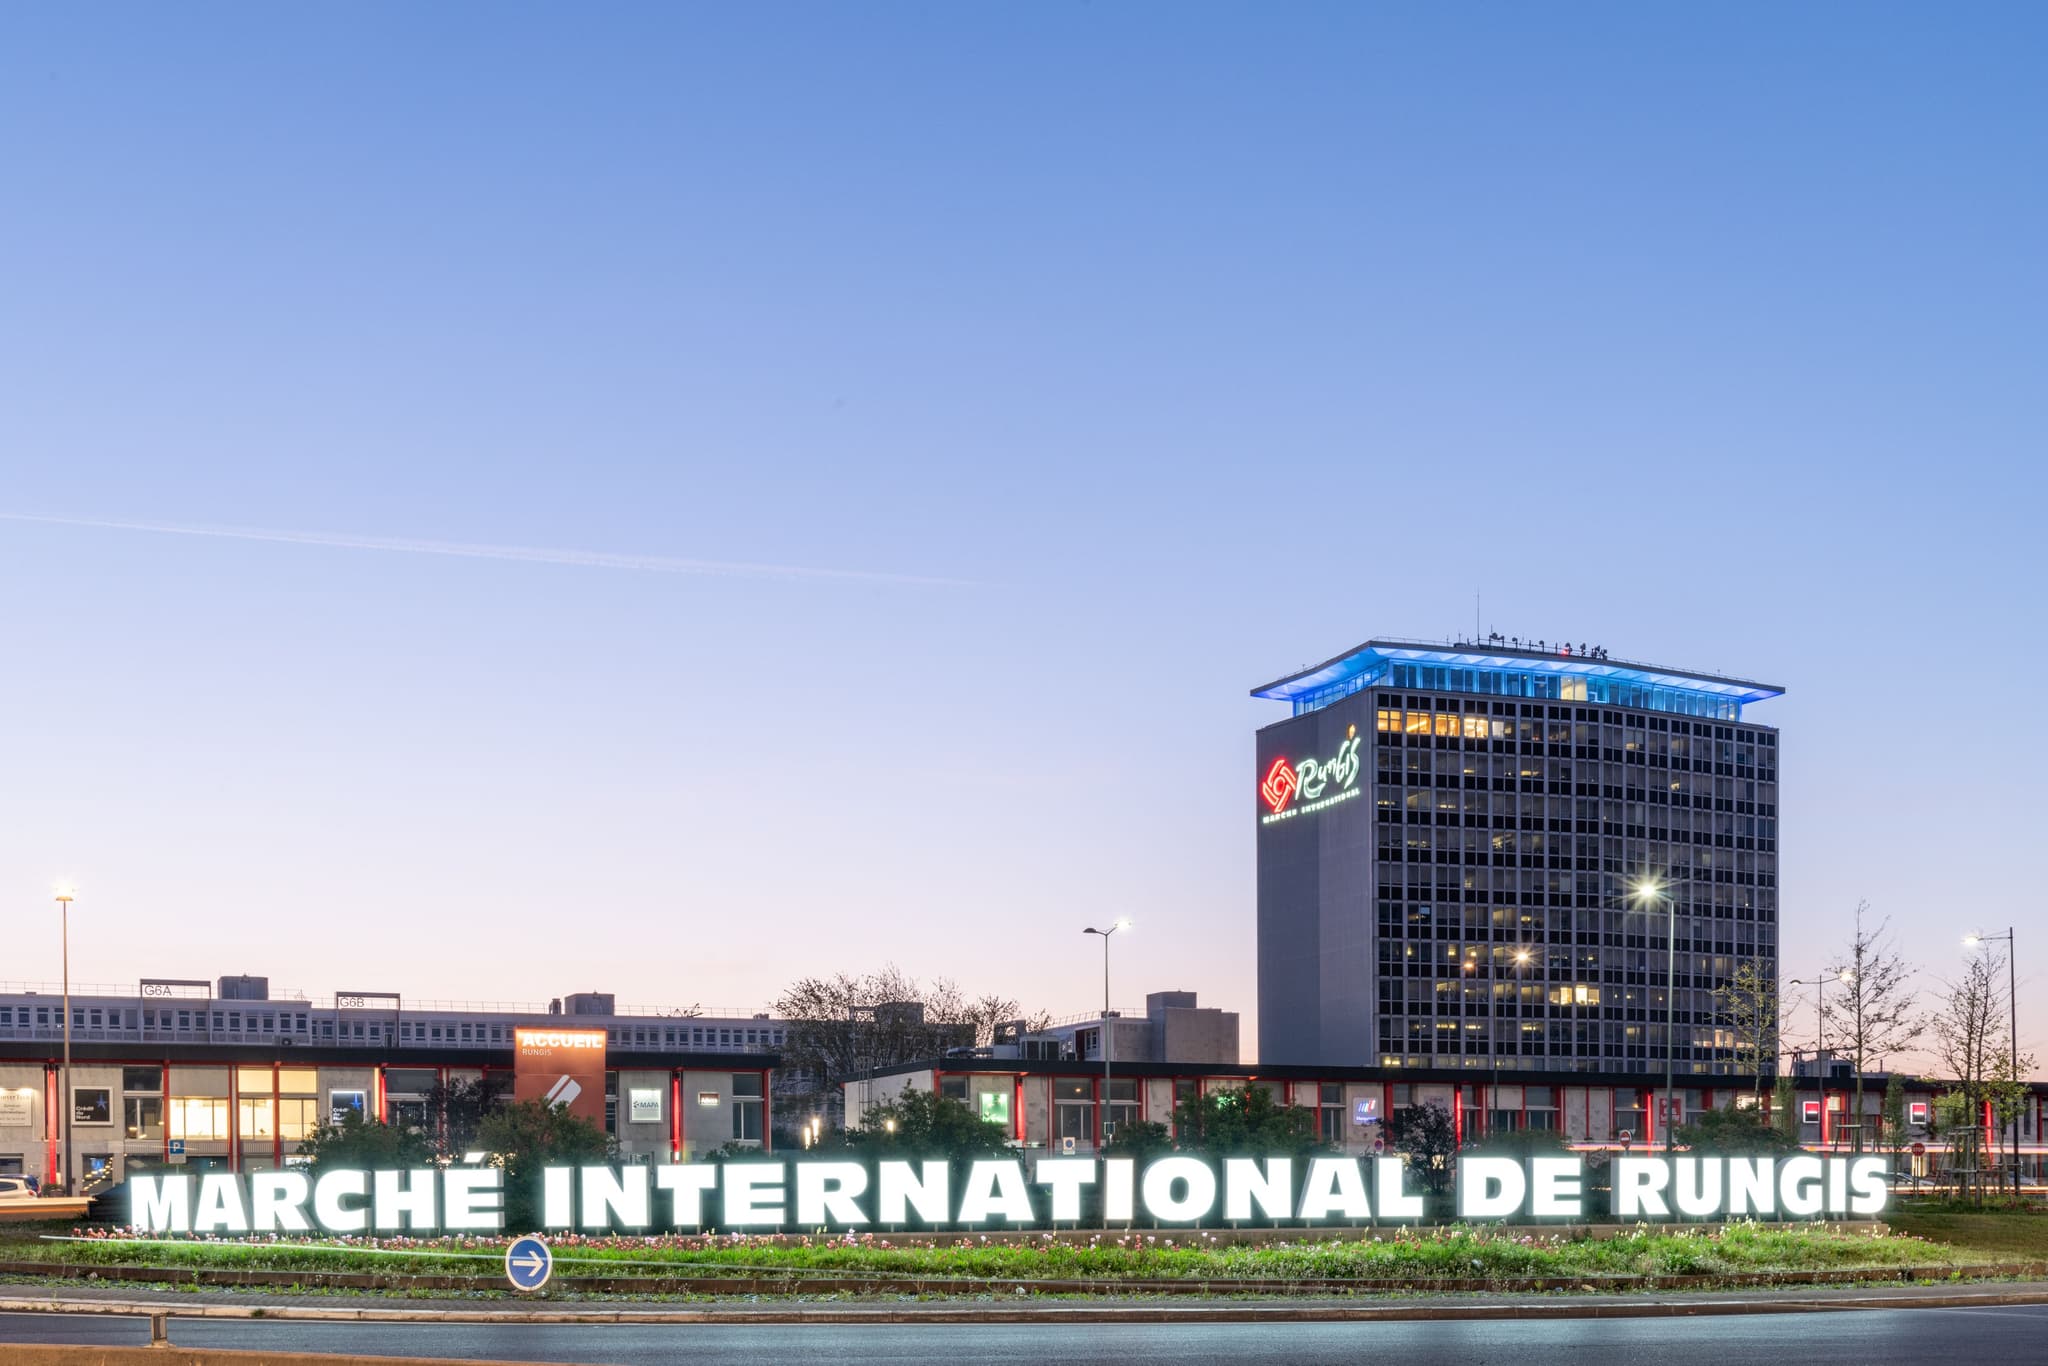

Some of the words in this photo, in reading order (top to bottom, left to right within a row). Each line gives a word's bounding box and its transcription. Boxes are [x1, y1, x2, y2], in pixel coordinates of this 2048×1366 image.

[1301, 787, 1361, 814] INTERNATIONAL
[144, 985, 172, 997] G6A
[339, 997, 365, 1008] G6B
[522, 1032, 603, 1049] ACCUEIL
[522, 1048, 553, 1056] RUNGIS
[173, 1141, 181, 1152] P
[130, 1151, 505, 1232] MARCHÉ
[543, 1157, 1424, 1228] INTERNATIONAL
[1456, 1156, 1583, 1219] DE
[1611, 1155, 1888, 1217] RUNGIS
